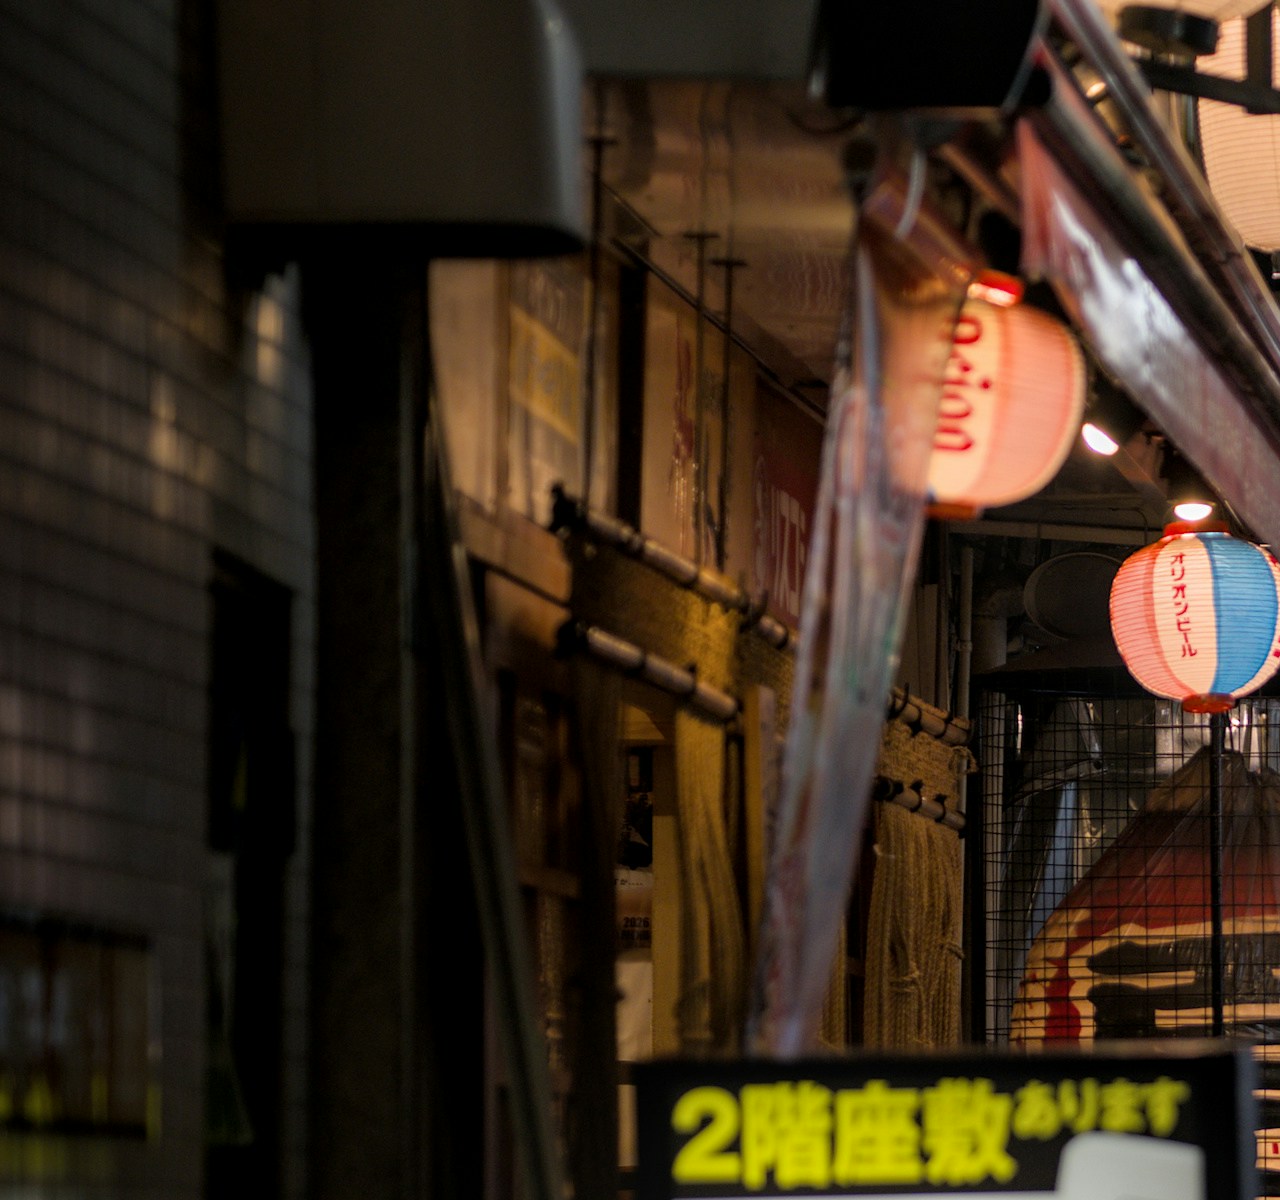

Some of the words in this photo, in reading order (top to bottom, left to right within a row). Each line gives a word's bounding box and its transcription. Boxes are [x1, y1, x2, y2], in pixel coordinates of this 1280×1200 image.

[1170, 552, 1198, 659] オリオンビール
